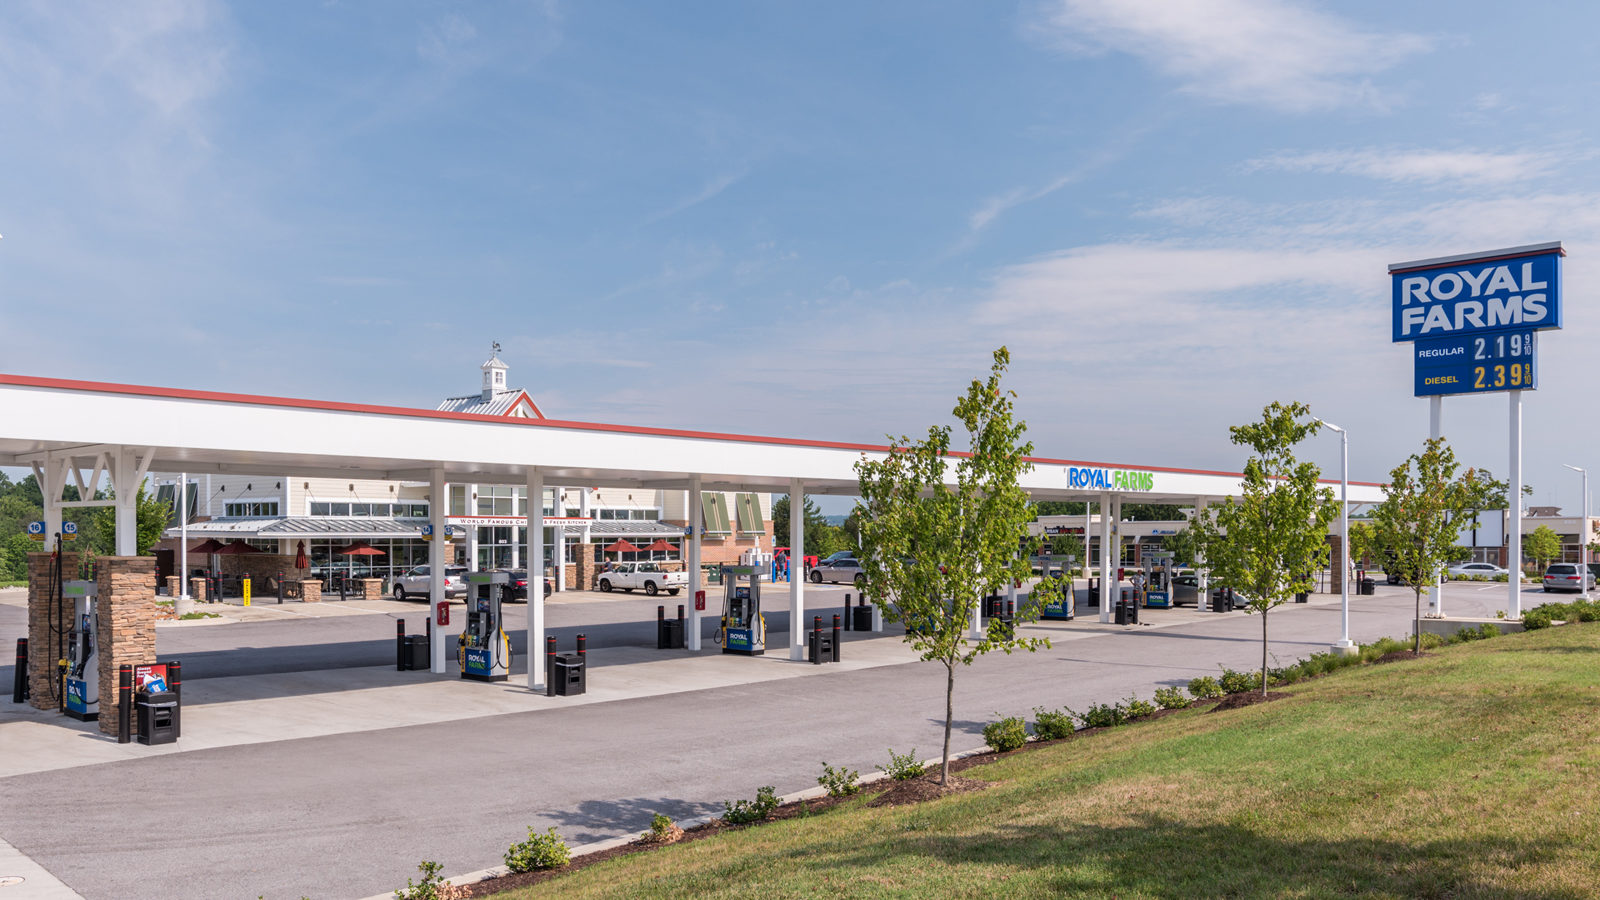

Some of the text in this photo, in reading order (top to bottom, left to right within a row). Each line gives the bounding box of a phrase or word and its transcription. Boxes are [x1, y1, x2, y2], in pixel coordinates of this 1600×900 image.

[1401, 262, 1548, 306] ROYAL
[1401, 293, 1548, 336] FARMS
[1418, 346, 1465, 358] REGULAR
[1474, 334, 1522, 360] 2.19
[1424, 375, 1459, 386] DIESEL
[1474, 363, 1523, 389] 2.39
[1067, 467, 1154, 491] ROYAL FARMS
[30, 523, 40, 531] 16
[66, 523, 75, 531] 15
[729, 632, 748, 641] ROYAL
